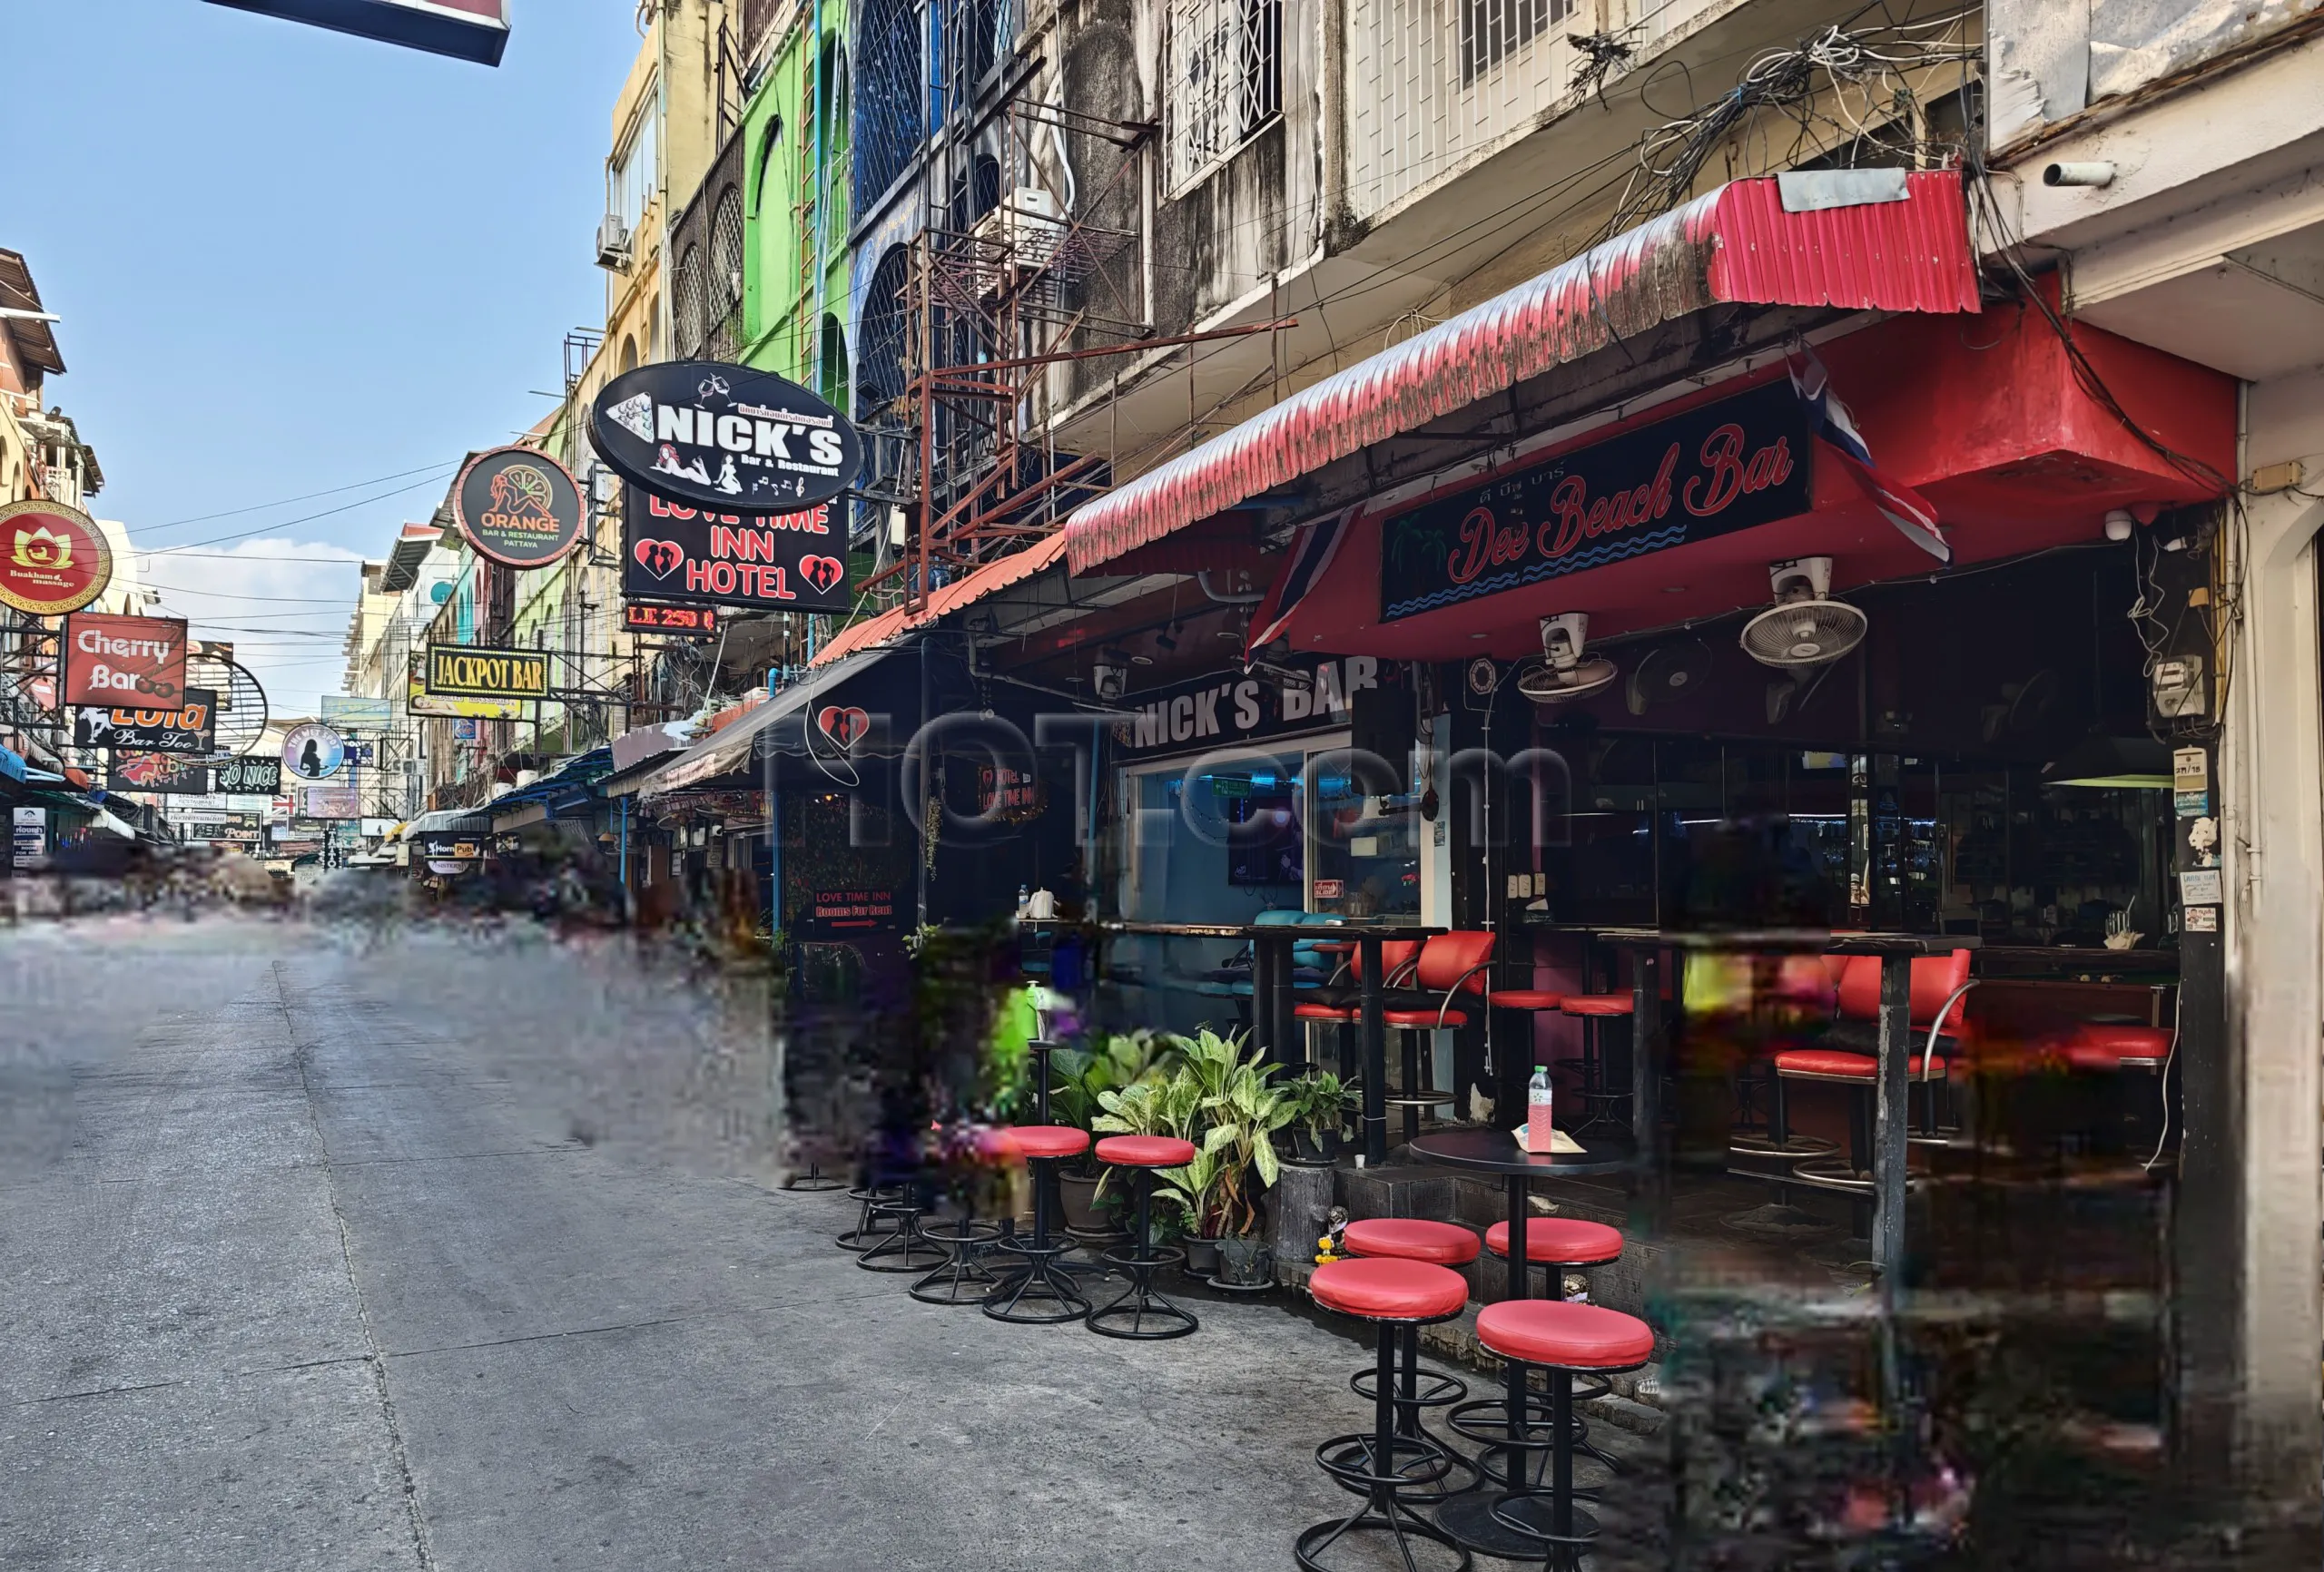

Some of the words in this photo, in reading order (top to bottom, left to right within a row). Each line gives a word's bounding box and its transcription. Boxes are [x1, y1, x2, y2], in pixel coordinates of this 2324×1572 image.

[657, 404, 843, 466] NICK'S
[741, 454, 761, 467] Bar
[765, 459, 773, 468] &
[777, 460, 840, 477] Restaurant
[1537, 441, 1680, 558] Beach
[1683, 423, 1794, 517] Bar
[481, 513, 560, 532] ORANGE
[482, 529, 498, 537] BAR
[508, 532, 559, 541] RESTAURANT
[504, 539, 537, 548] PATTAYA
[711, 526, 774, 563] INN
[10, 569, 53, 580] Buakham
[33, 578, 74, 588] massage
[686, 558, 797, 600] HOTEL
[78, 630, 169, 663] Cherry
[88, 664, 142, 690] Bar
[436, 655, 509, 688] JACKPOT
[512, 660, 542, 690] BAR
[1135, 680, 1260, 749] NICK'S
[113, 729, 155, 746] Bar
[159, 732, 194, 749] Too
[288, 733, 301, 748] THE
[301, 729, 320, 737] WET
[322, 732, 340, 749] SPOT
[220, 764, 241, 786] SO
[243, 765, 278, 787] NICE
[996, 768, 1019, 785] HOTEL
[1003, 788, 1020, 807] TIME
[224, 828, 259, 839] POINT
[436, 844, 455, 853] Horn
[457, 845, 472, 853] Pub
[816, 892, 842, 902] LOVE
[845, 891, 869, 901] TIME
[872, 891, 891, 900] INN
[816, 906, 851, 917] Rooms
[852, 905, 869, 916] For
[869, 905, 892, 915] Rent
